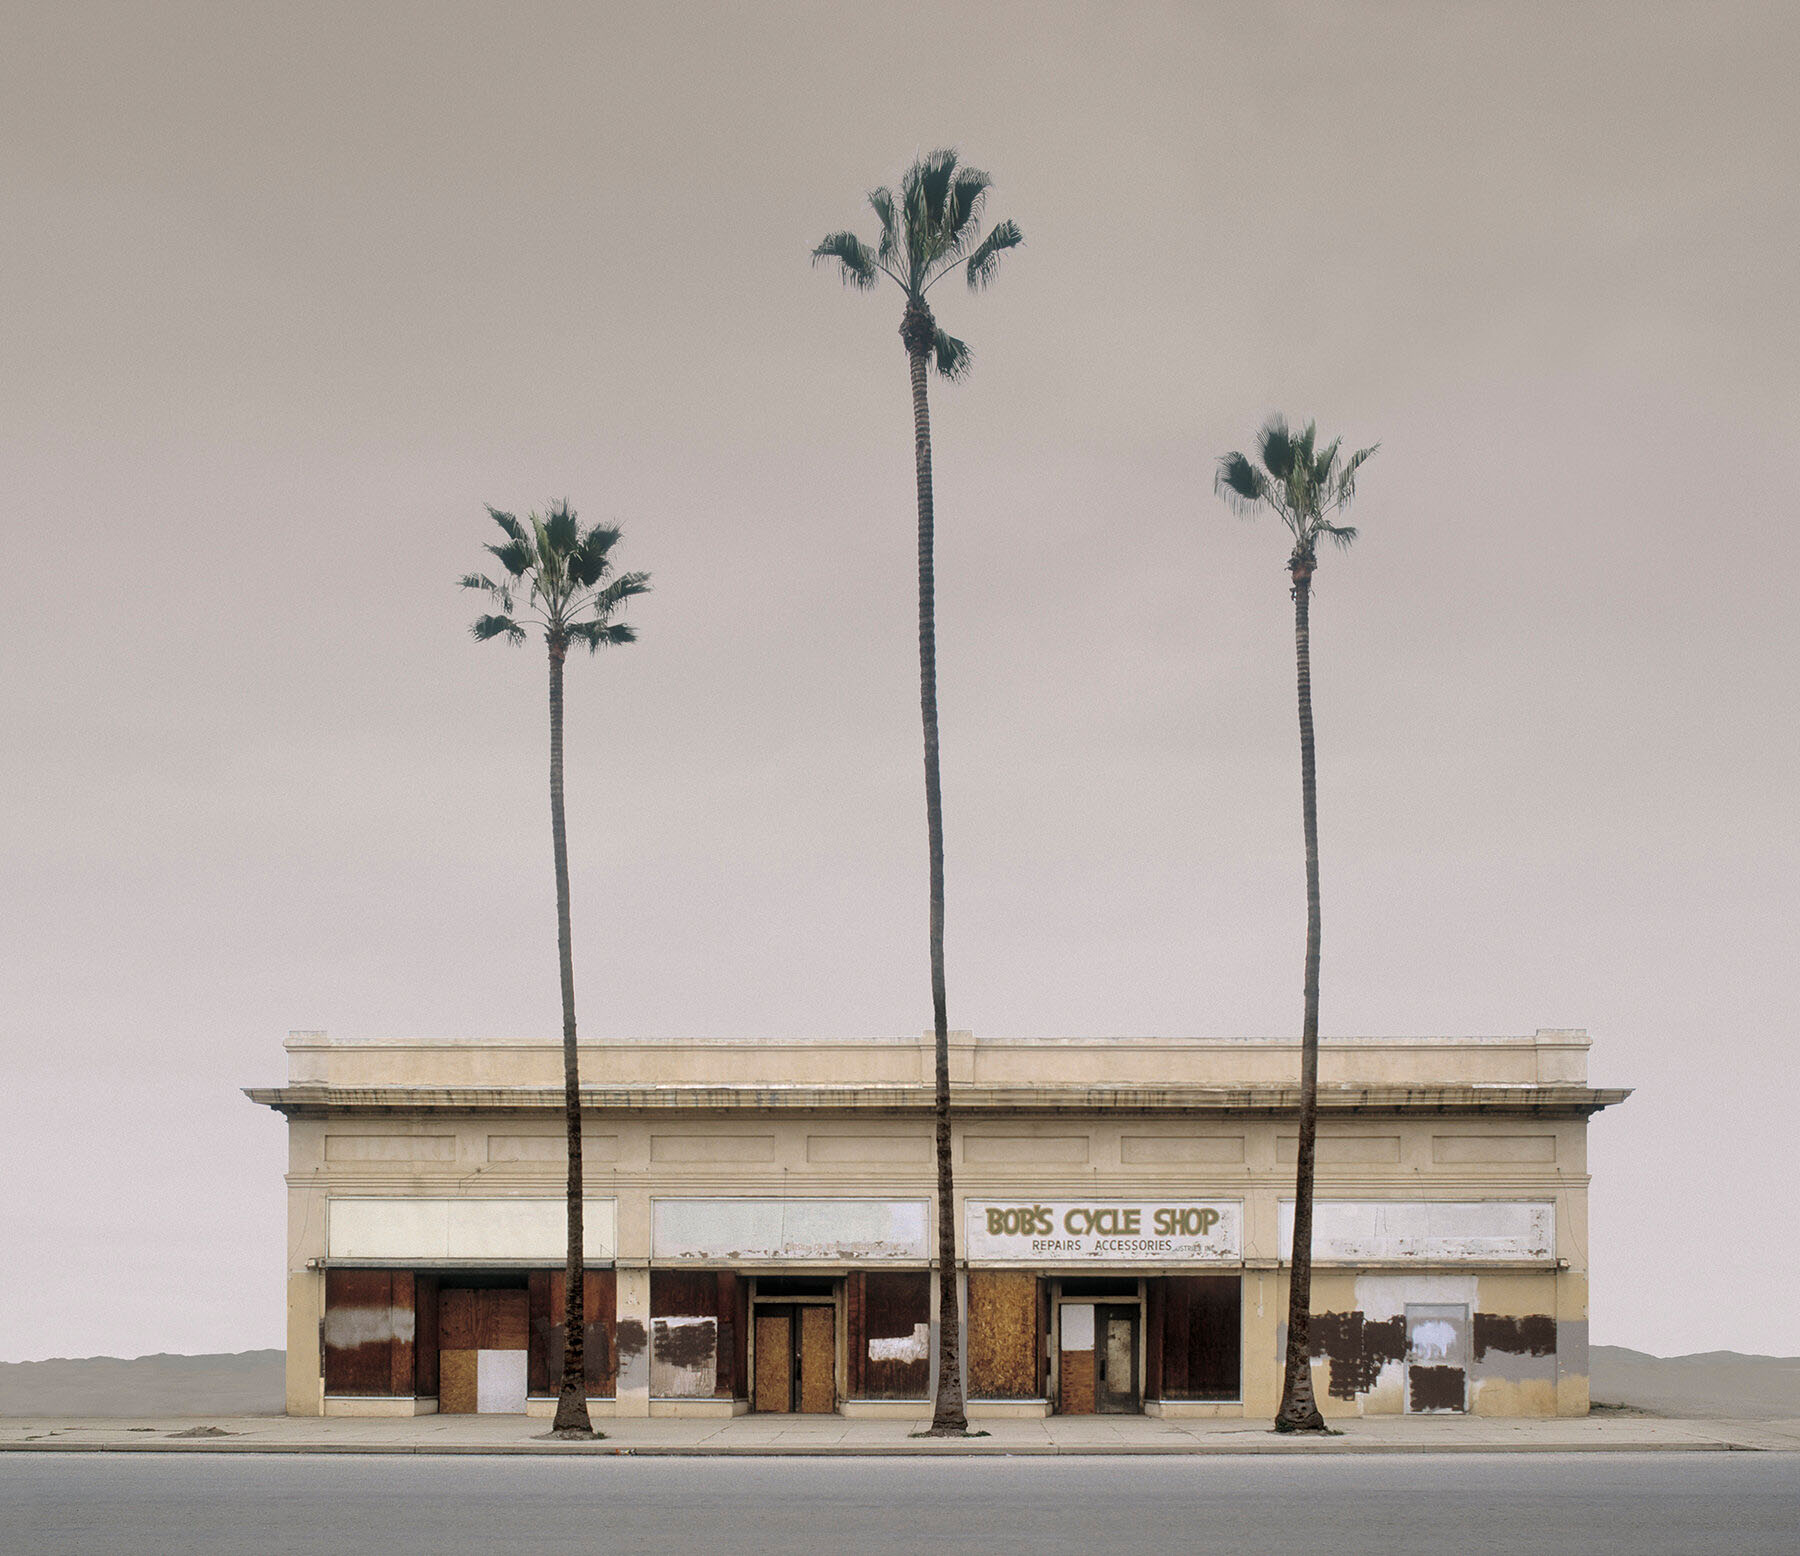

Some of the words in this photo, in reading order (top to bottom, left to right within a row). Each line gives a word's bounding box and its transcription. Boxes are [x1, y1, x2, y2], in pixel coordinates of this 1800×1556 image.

[986, 1205, 1054, 1236] BOB'S
[1064, 1208, 1141, 1236] CYCLE
[1154, 1208, 1220, 1236] SHOP
[1032, 1240, 1081, 1251] REPAIRS
[1095, 1240, 1172, 1251] ACCESSORIES
